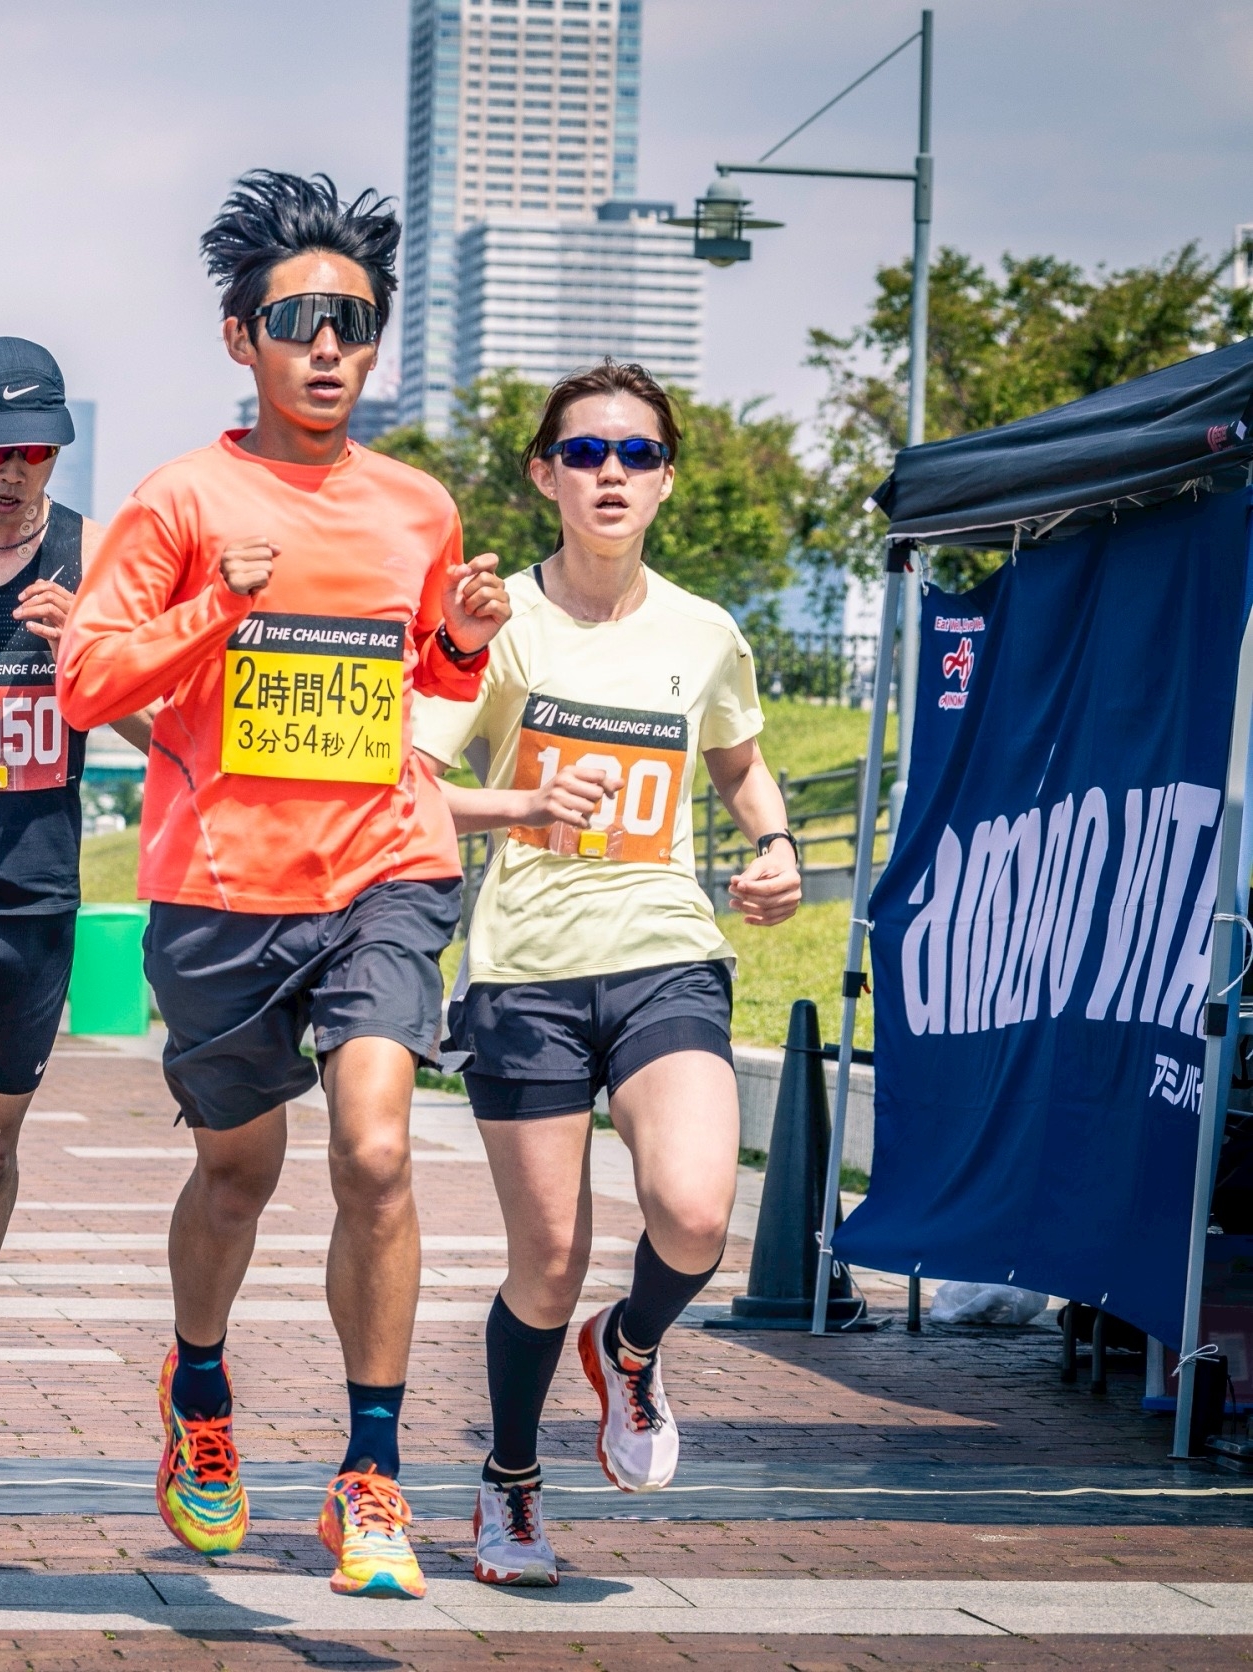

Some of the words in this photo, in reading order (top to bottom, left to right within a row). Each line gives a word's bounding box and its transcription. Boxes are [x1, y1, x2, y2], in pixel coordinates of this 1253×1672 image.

[266, 627, 290, 641] THE
[293, 629, 367, 646] CHALLENGE
[369, 634, 398, 648] RACE
[234, 656, 395, 721] 2時間45分
[237, 719, 391, 759] 3分54秒/km
[557, 711, 582, 727] THE
[582, 714, 651, 736] CHALLENGE
[652, 723, 681, 739] RACE
